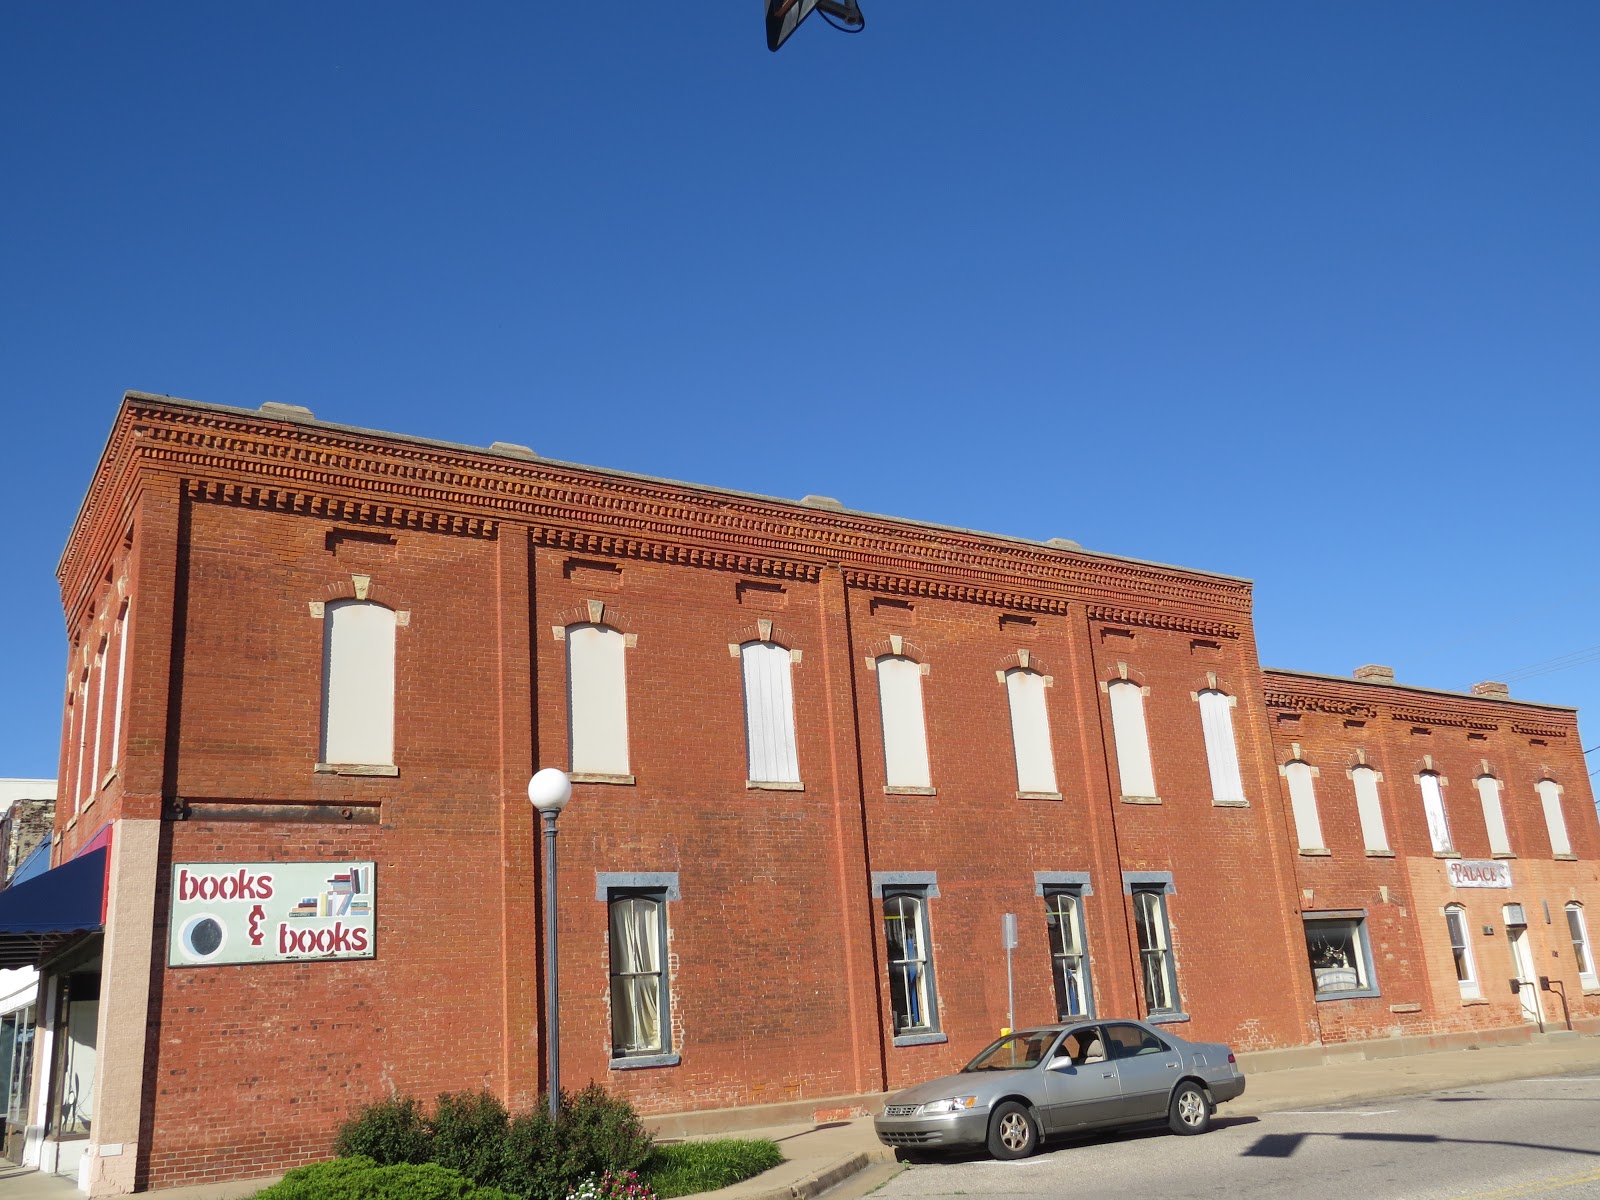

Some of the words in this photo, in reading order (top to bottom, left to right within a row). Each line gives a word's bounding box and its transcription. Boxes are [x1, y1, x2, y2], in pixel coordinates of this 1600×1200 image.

[179, 869, 273, 900] books
[248, 905, 265, 945] &
[279, 922, 368, 954] books
